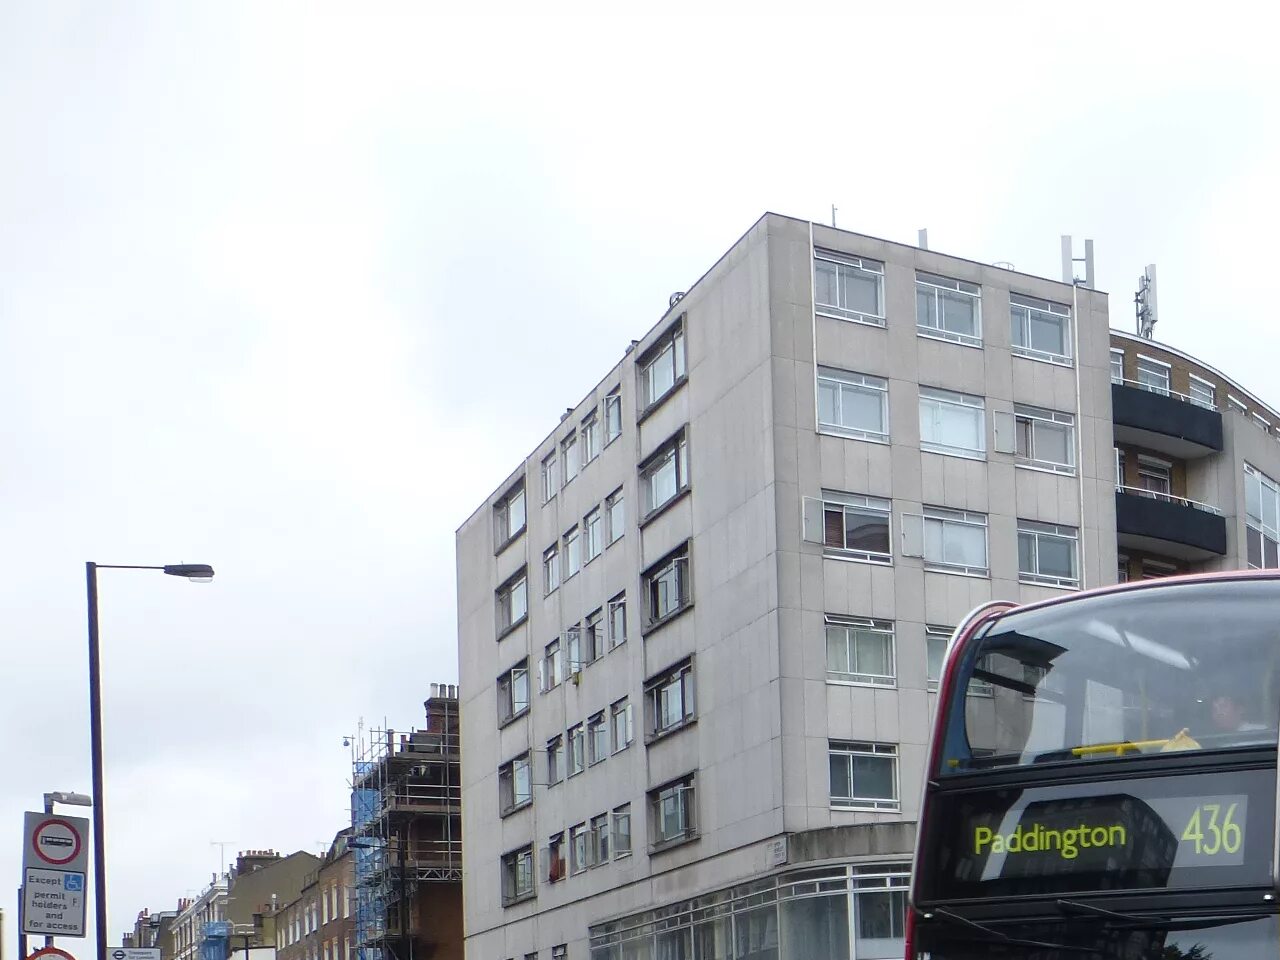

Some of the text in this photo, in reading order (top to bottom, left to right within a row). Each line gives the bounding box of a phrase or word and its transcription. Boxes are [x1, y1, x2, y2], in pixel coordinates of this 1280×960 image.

[974, 802, 1243, 859] Paddington 436
[28, 875, 62, 886] Except
[34, 892, 65, 900] permit
[31, 900, 68, 910] holders
[45, 912, 63, 920] and
[29, 919, 78, 931] for access
